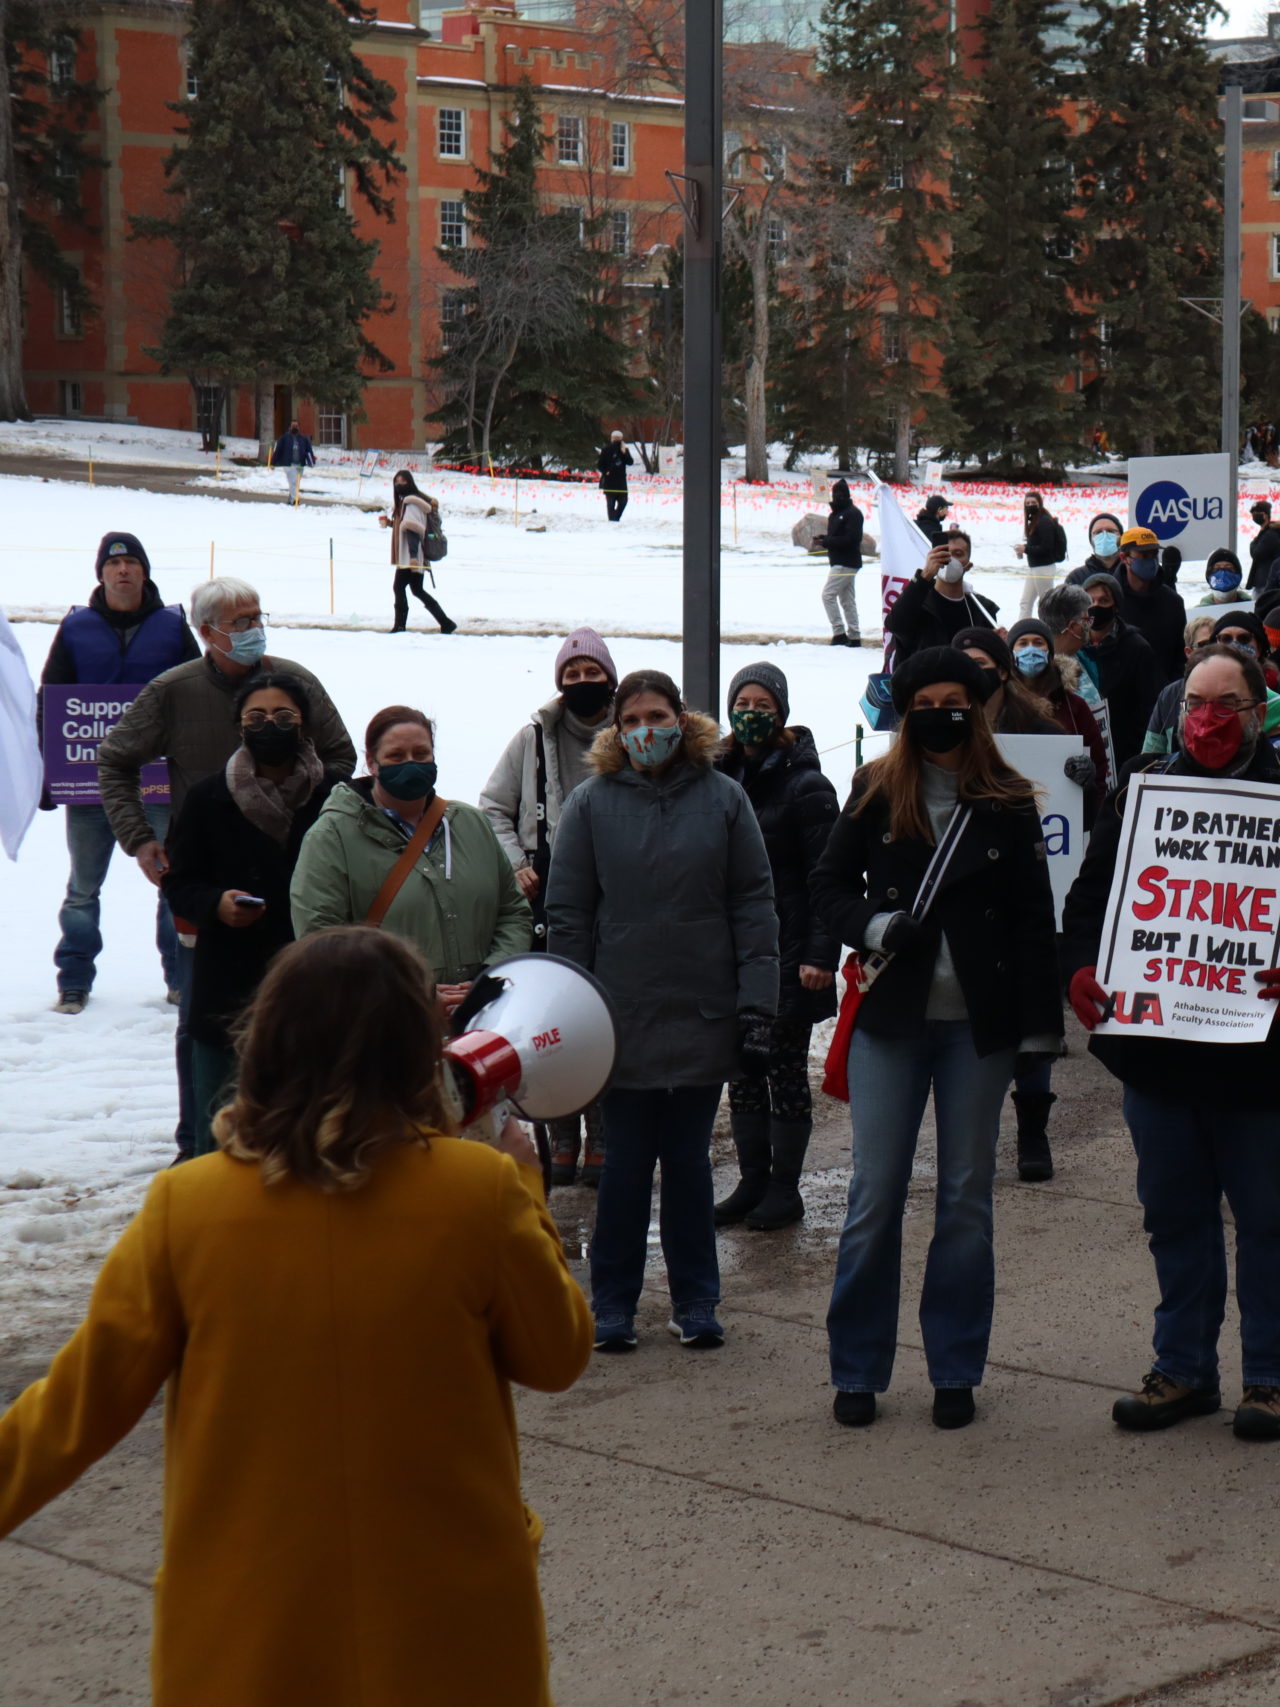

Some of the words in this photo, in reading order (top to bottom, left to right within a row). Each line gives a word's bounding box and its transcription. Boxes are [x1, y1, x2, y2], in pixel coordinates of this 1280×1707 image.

[66, 698, 134, 719] Suppo
[62, 721, 116, 739] Colle
[1154, 807, 1189, 831] I'D
[1155, 837, 1209, 861] WORK
[1132, 865, 1277, 935] STRIKE.
[1131, 929, 1181, 953] BUT
[1188, 934, 1199, 958] I
[1207, 936, 1265, 966] WILL
[1144, 957, 1248, 995] STRIKE.
[1171, 1013, 1203, 1025] Faculty
[1205, 1018, 1254, 1029] Association
[1174, 1001, 1220, 1015] Athabasca
[1222, 1007, 1267, 1019] University
[532, 1028, 561, 1051] PYLE
